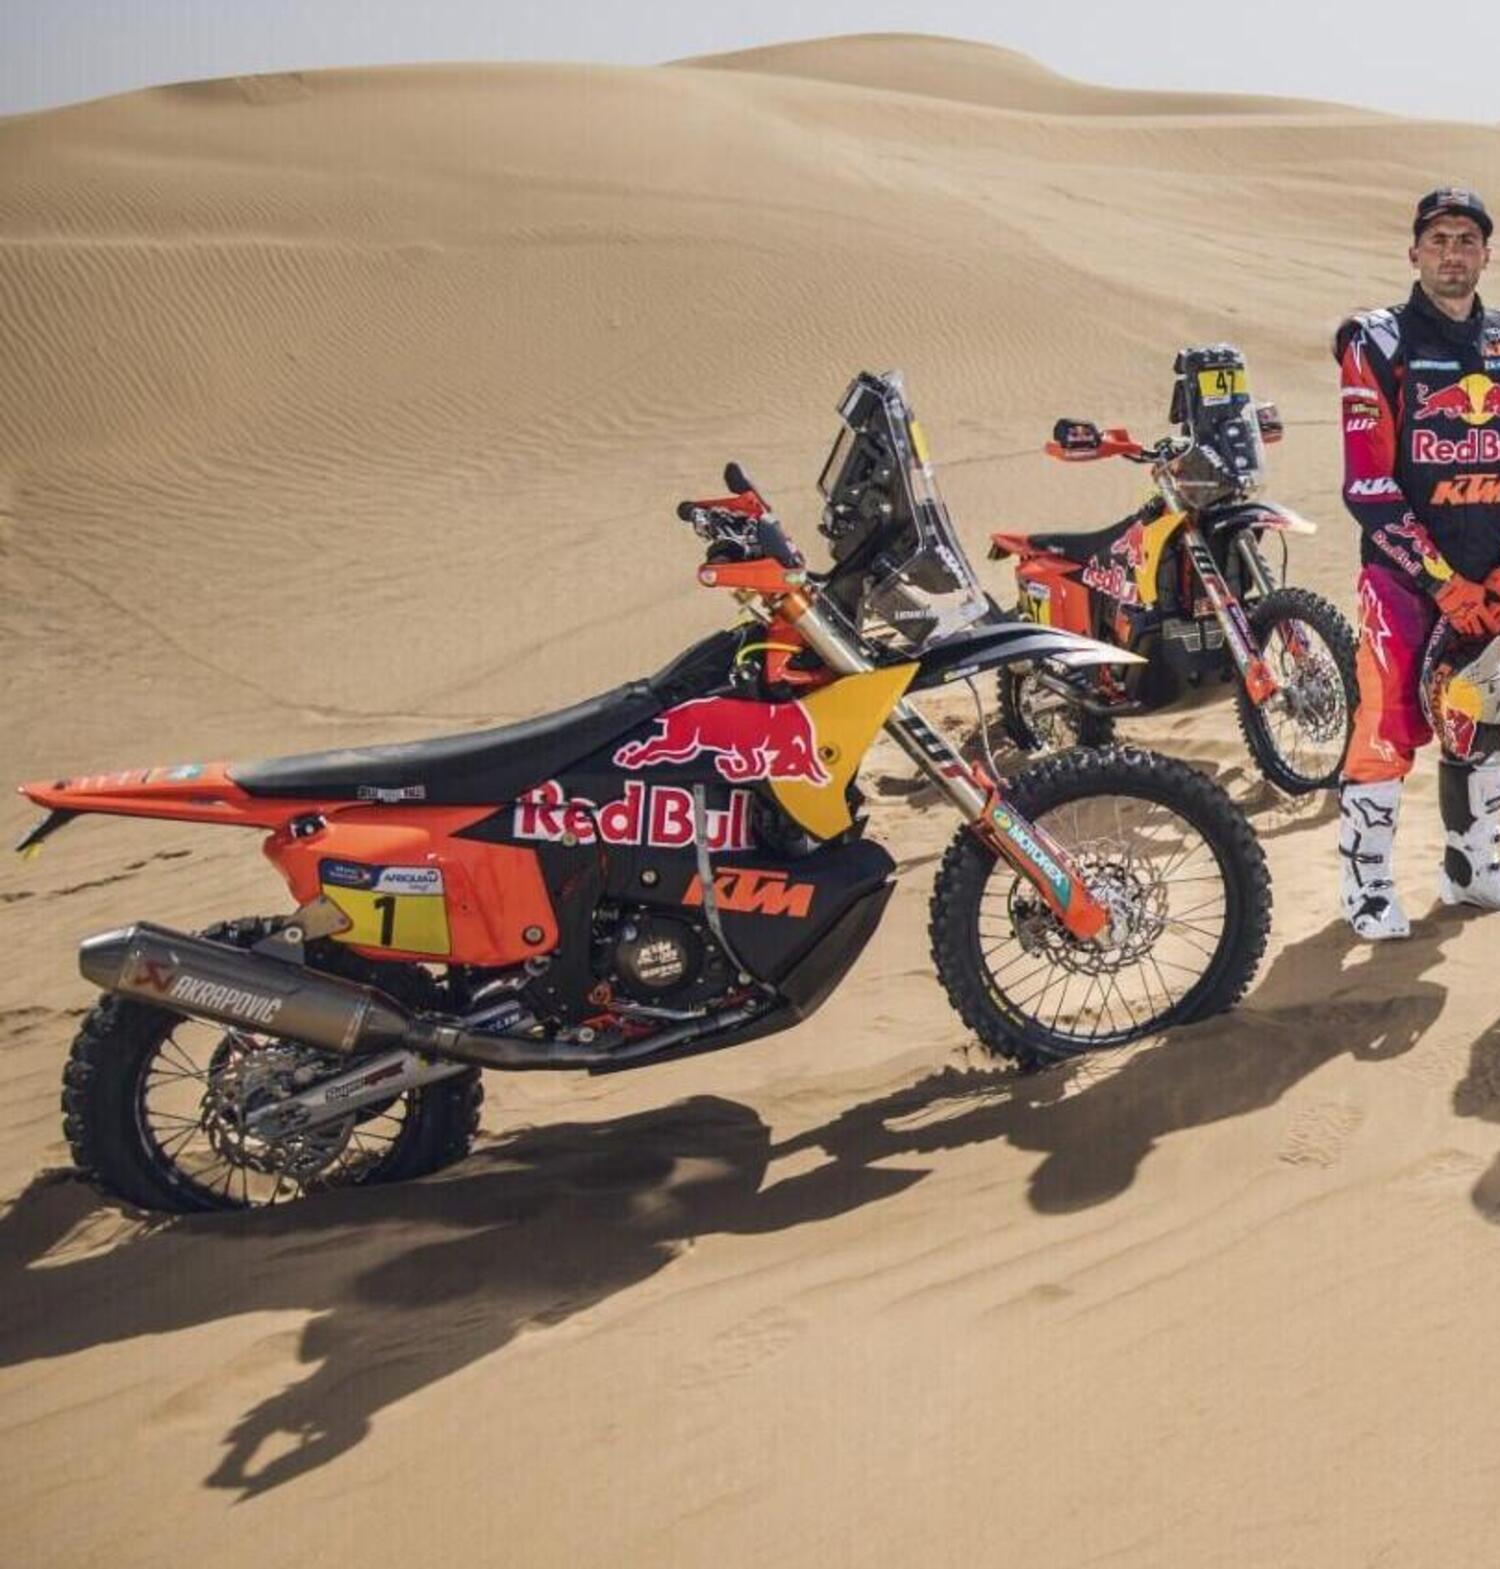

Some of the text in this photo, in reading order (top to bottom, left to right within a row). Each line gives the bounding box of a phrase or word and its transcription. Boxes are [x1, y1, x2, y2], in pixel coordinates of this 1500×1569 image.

[1216, 369, 1236, 395] 47
[1412, 429, 1479, 463] Red
[513, 779, 645, 845] Red
[1008, 823, 1066, 887] MOTOREX
[682, 867, 815, 918] KTM
[374, 896, 396, 946] 1
